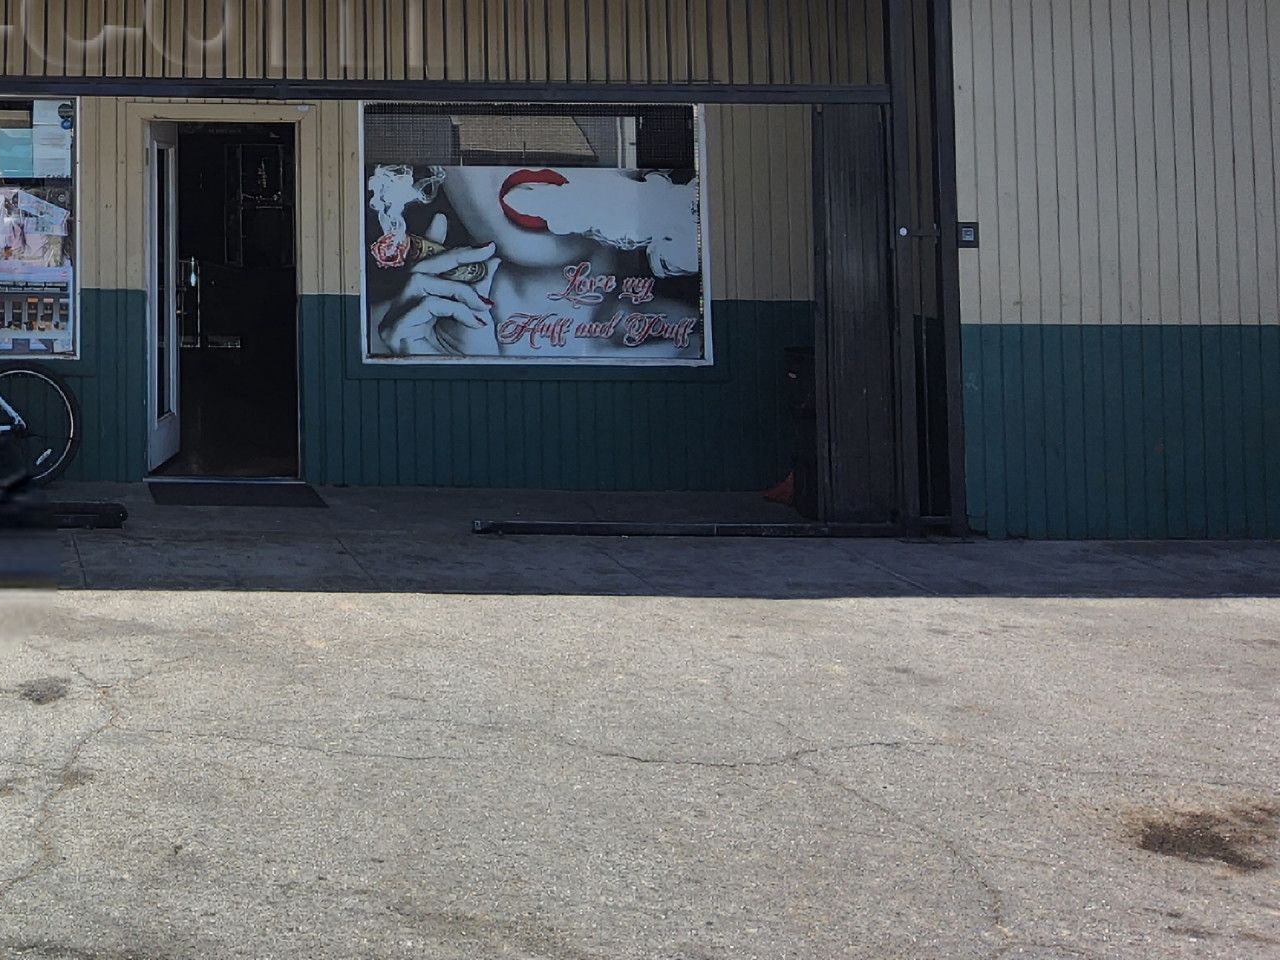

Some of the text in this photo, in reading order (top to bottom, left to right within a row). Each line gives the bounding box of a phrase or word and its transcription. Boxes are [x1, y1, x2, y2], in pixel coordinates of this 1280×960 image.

[547, 261, 656, 309] Love my
[497, 310, 697, 349] Huff and Puff
